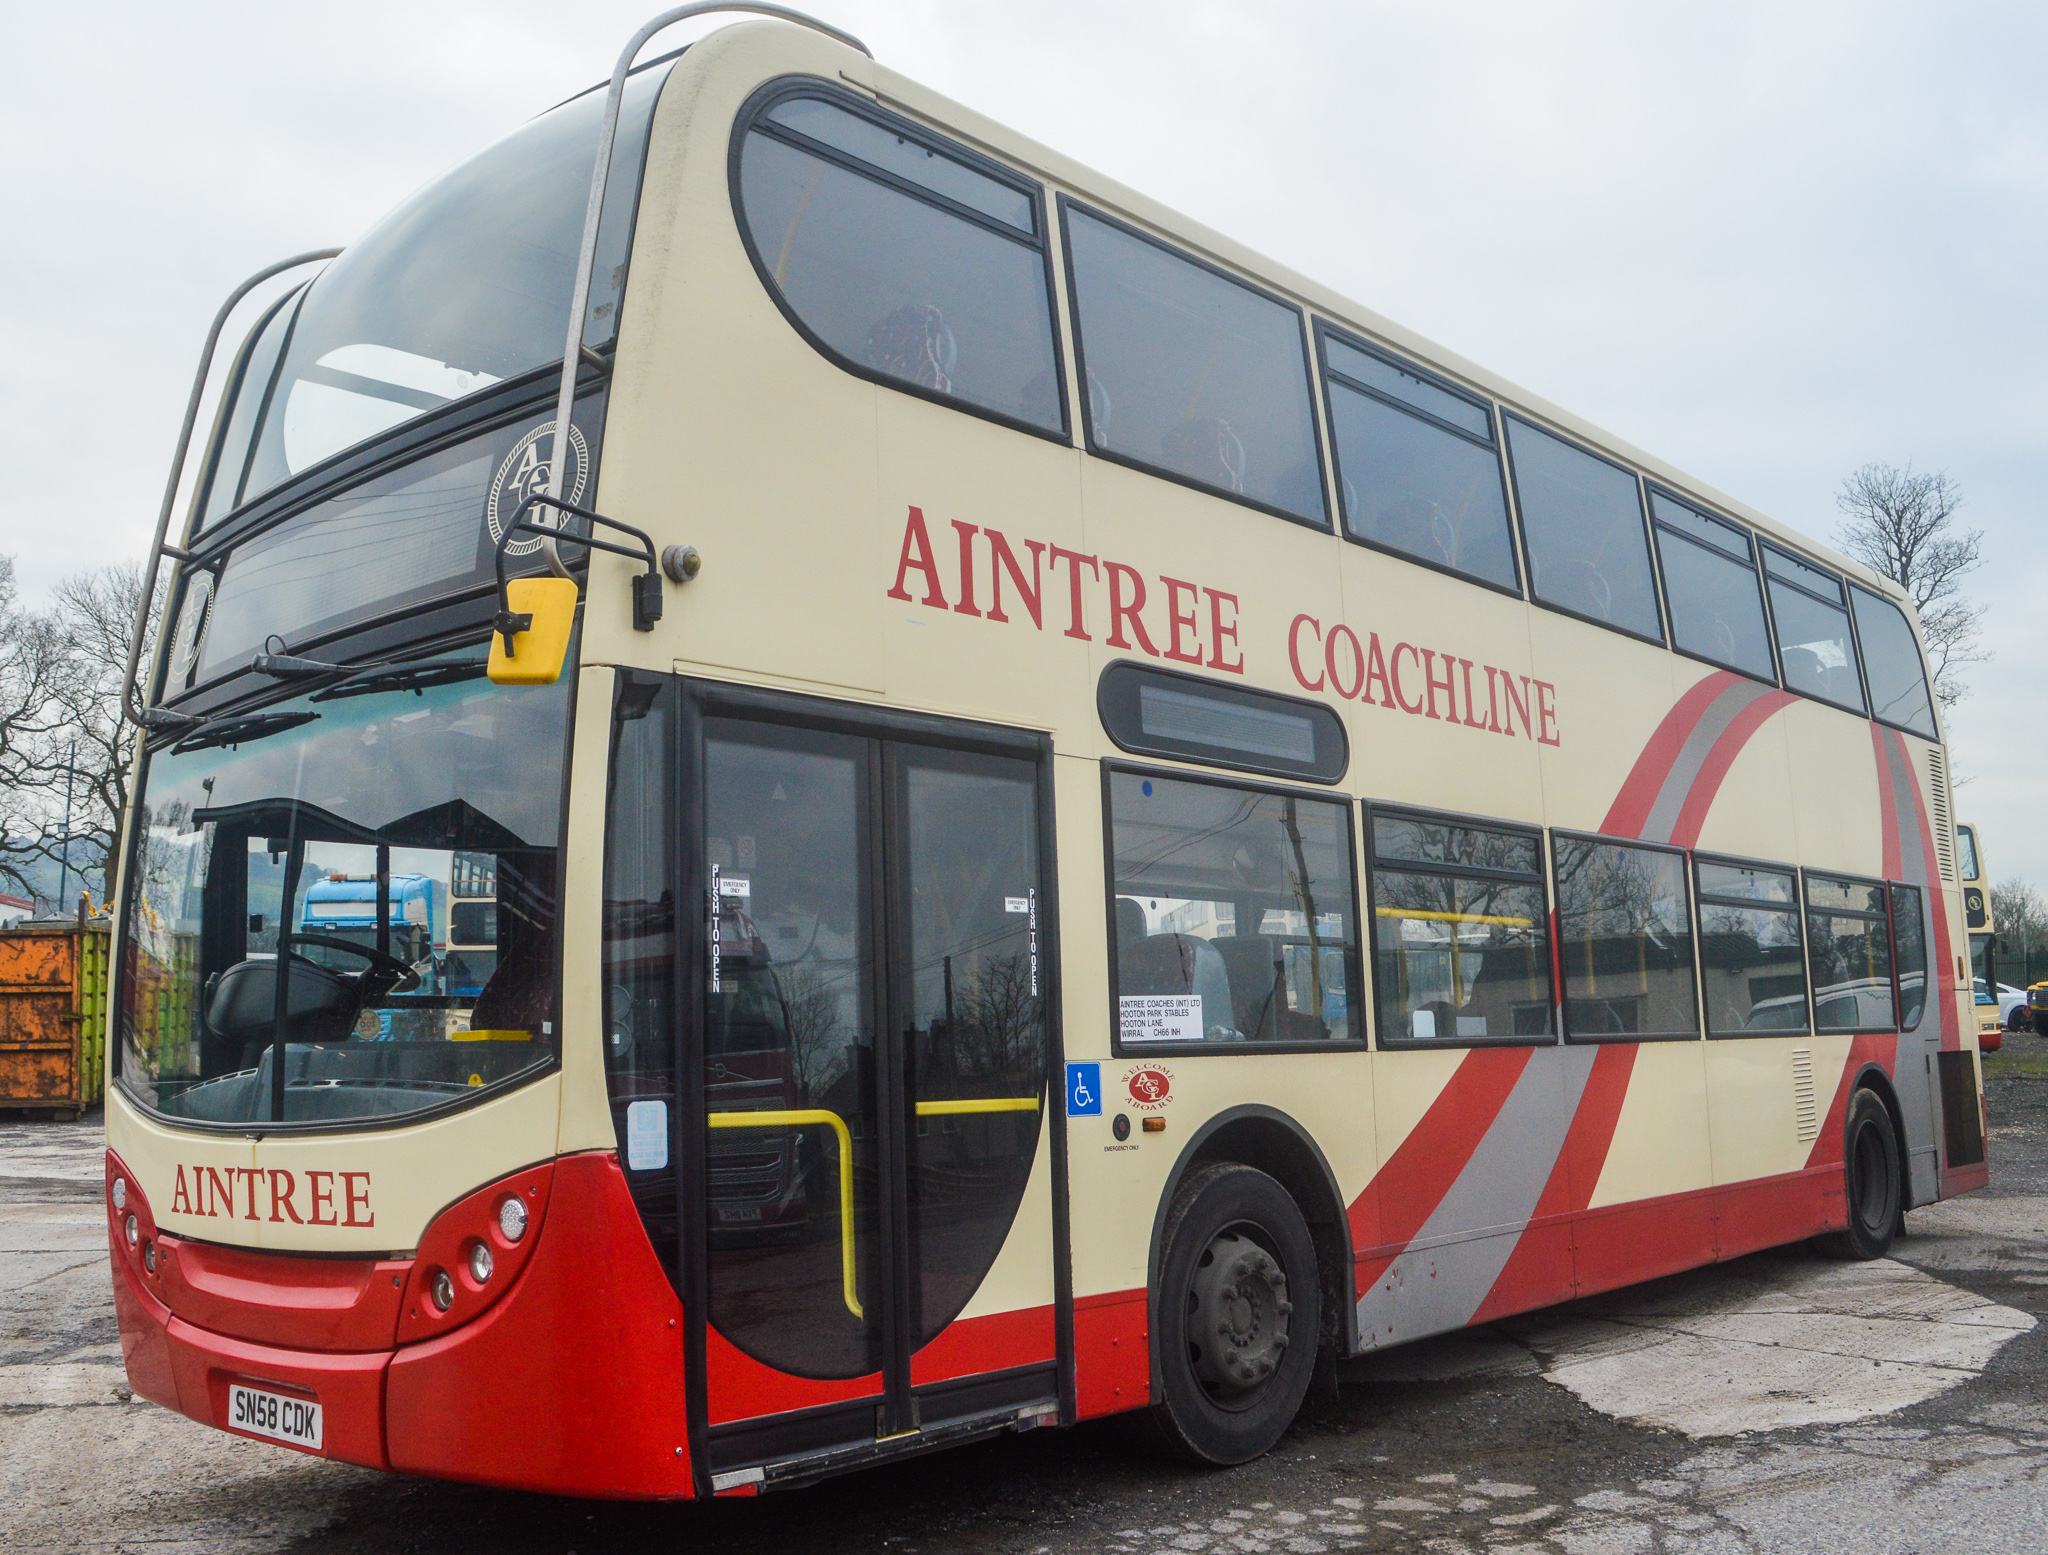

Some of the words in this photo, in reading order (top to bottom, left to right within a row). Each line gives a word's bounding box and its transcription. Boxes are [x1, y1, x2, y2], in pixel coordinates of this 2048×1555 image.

[887, 504, 1244, 675] AINTREE
[1288, 613, 1560, 747] COACHLINE
[712, 864, 720, 914] PUSH
[712, 916, 720, 942] TO
[1030, 932, 1037, 954] TO
[712, 944, 720, 993] OPEN
[1120, 1000, 1145, 1009] AINTREE
[1146, 999, 1175, 1008] COACHES
[1175, 999, 1189, 1008] (INT)
[1190, 999, 1200, 1007] LTD
[1120, 1009, 1146, 1018] HOOTON
[1147, 1009, 1162, 1018] PARK
[1164, 1008, 1189, 1017] STABLES
[1120, 1019, 1146, 1028] HOOTON
[1147, 1019, 1163, 1027] LANE
[1121, 1029, 1144, 1038] WIRRAL
[1153, 1028, 1169, 1037] CH66
[1121, 1063, 1175, 1083] WELCOME
[1125, 1095, 1174, 1111] ABOARD
[172, 1164, 375, 1228] AINTREE
[236, 1390, 277, 1430] SN58
[283, 1401, 315, 1440] CDK
